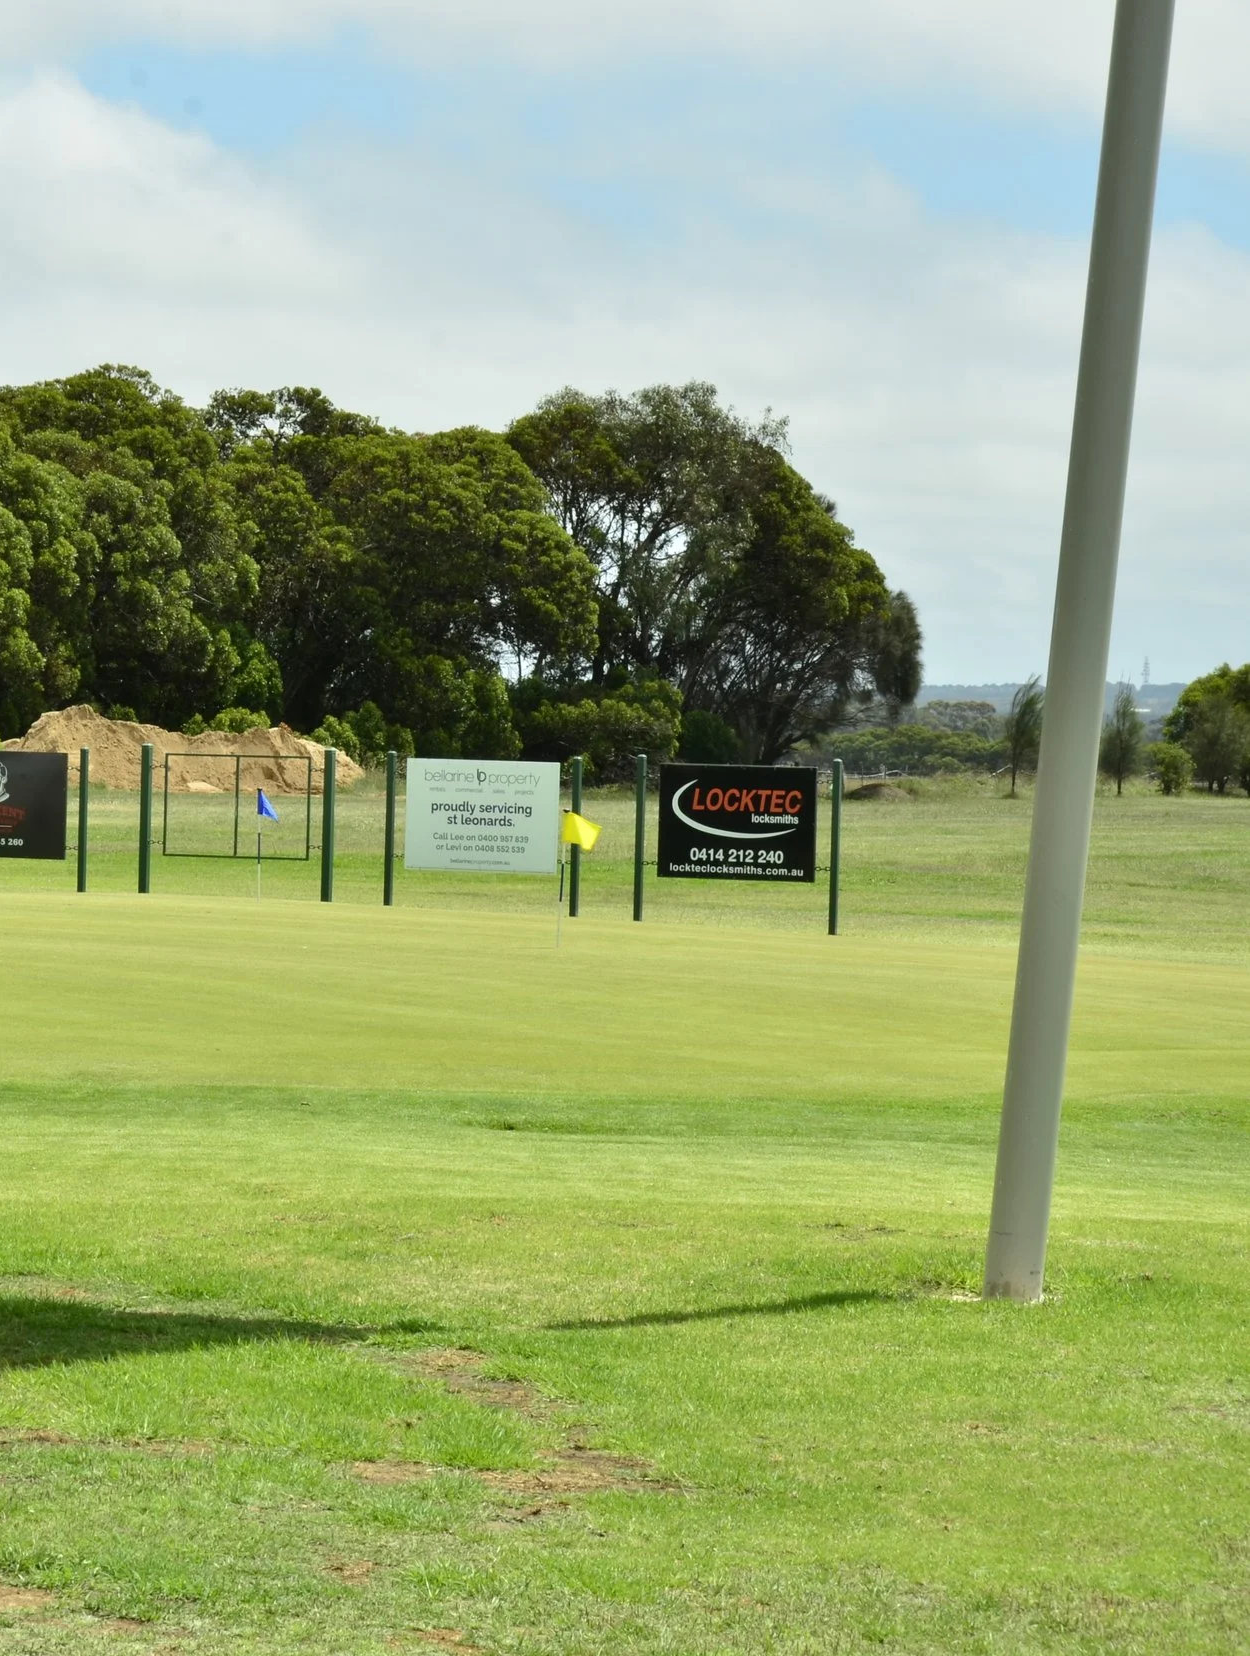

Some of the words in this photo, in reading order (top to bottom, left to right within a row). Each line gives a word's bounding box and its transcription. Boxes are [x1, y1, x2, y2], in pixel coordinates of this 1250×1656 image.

[424, 768, 475, 783] bellarine
[488, 773, 541, 788] property
[692, 788, 802, 814] LOCKTEC
[431, 801, 476, 815] proudly
[479, 803, 532, 817] servicing
[447, 815, 457, 825] st
[461, 814, 515, 827] leonards.
[751, 813, 799, 825] locksmiths
[8, 838, 24, 846] 260
[433, 832, 448, 840] Call
[450, 832, 464, 841] Lee
[478, 834, 498, 842] 0400
[475, 844, 494, 852] 0408
[690, 847, 725, 862] 0414
[728, 848, 754, 863] 212
[757, 850, 784, 864] 240
[669, 862, 804, 877] lockteclocksmiths.com.au
